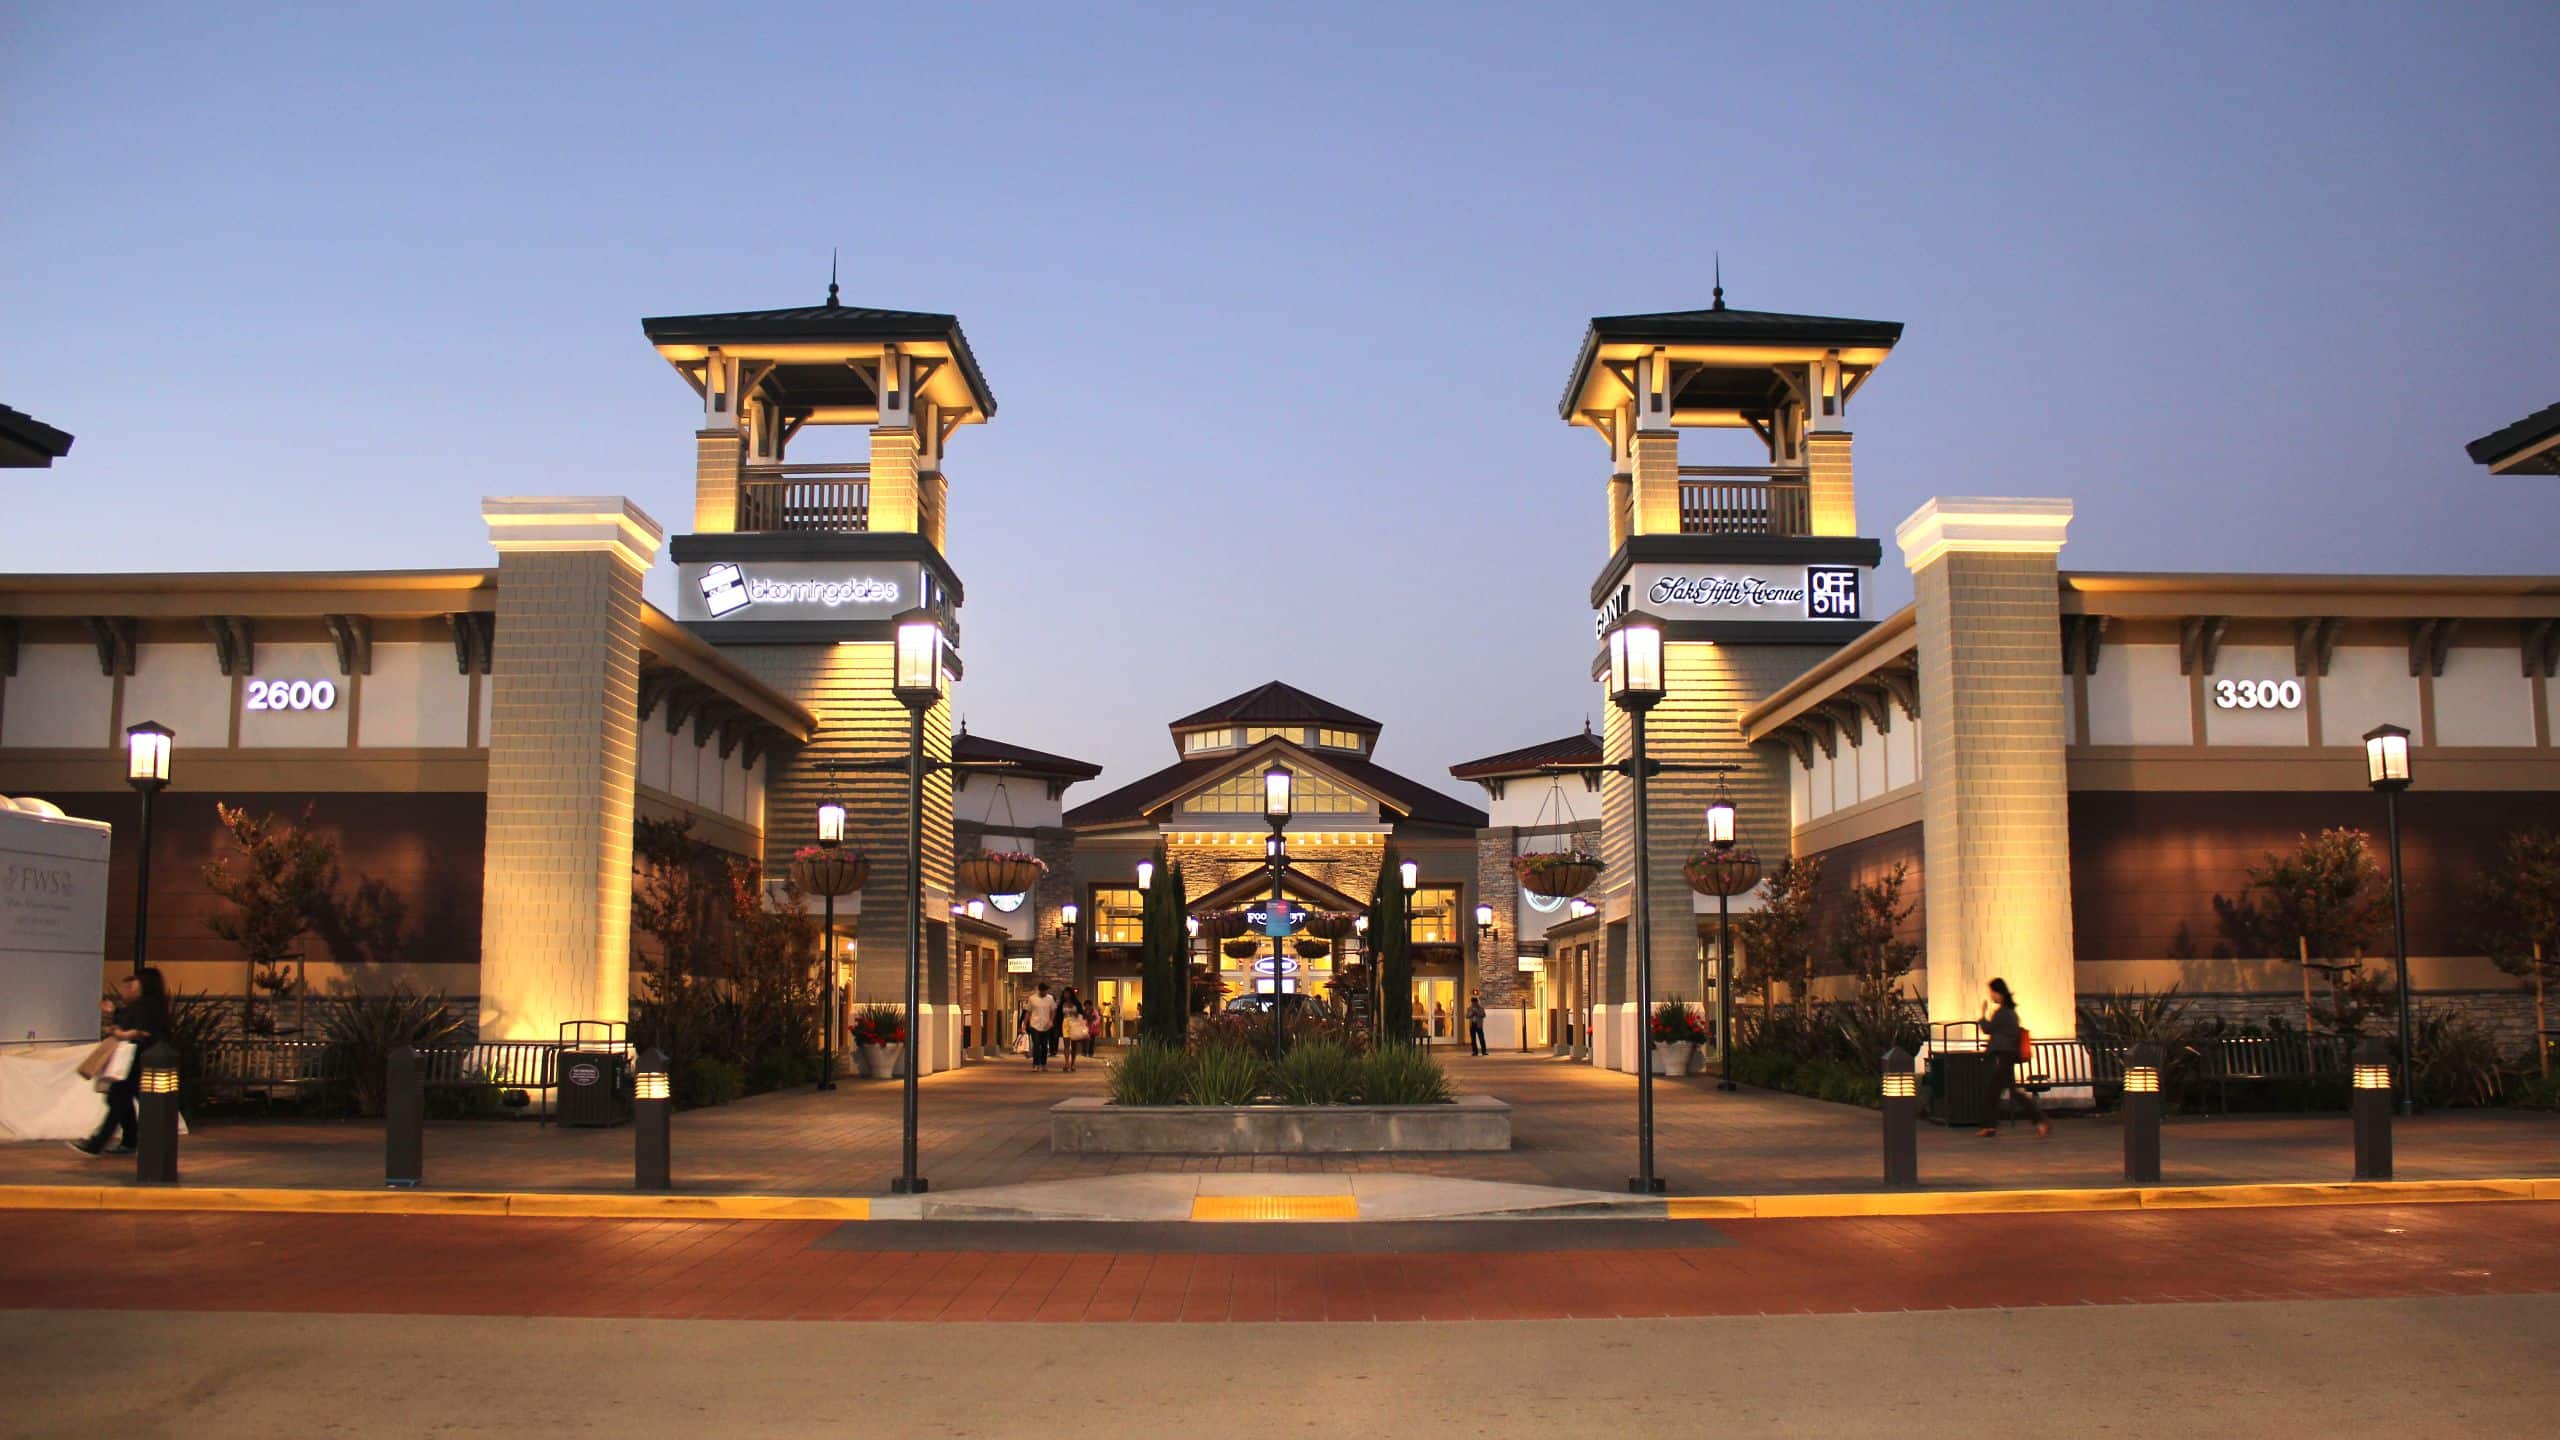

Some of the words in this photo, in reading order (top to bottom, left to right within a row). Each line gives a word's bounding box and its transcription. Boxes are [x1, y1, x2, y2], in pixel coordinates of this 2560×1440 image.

[1650, 577, 1699, 603] Saks
[1699, 577, 1741, 604] Fifth
[1735, 577, 1803, 604] Avenue
[1813, 573, 1854, 593] OFF
[1596, 585, 1631, 640] GANT
[1814, 592, 1855, 614] 5TH
[247, 680, 335, 710] 2600
[2216, 679, 2301, 709] 3300
